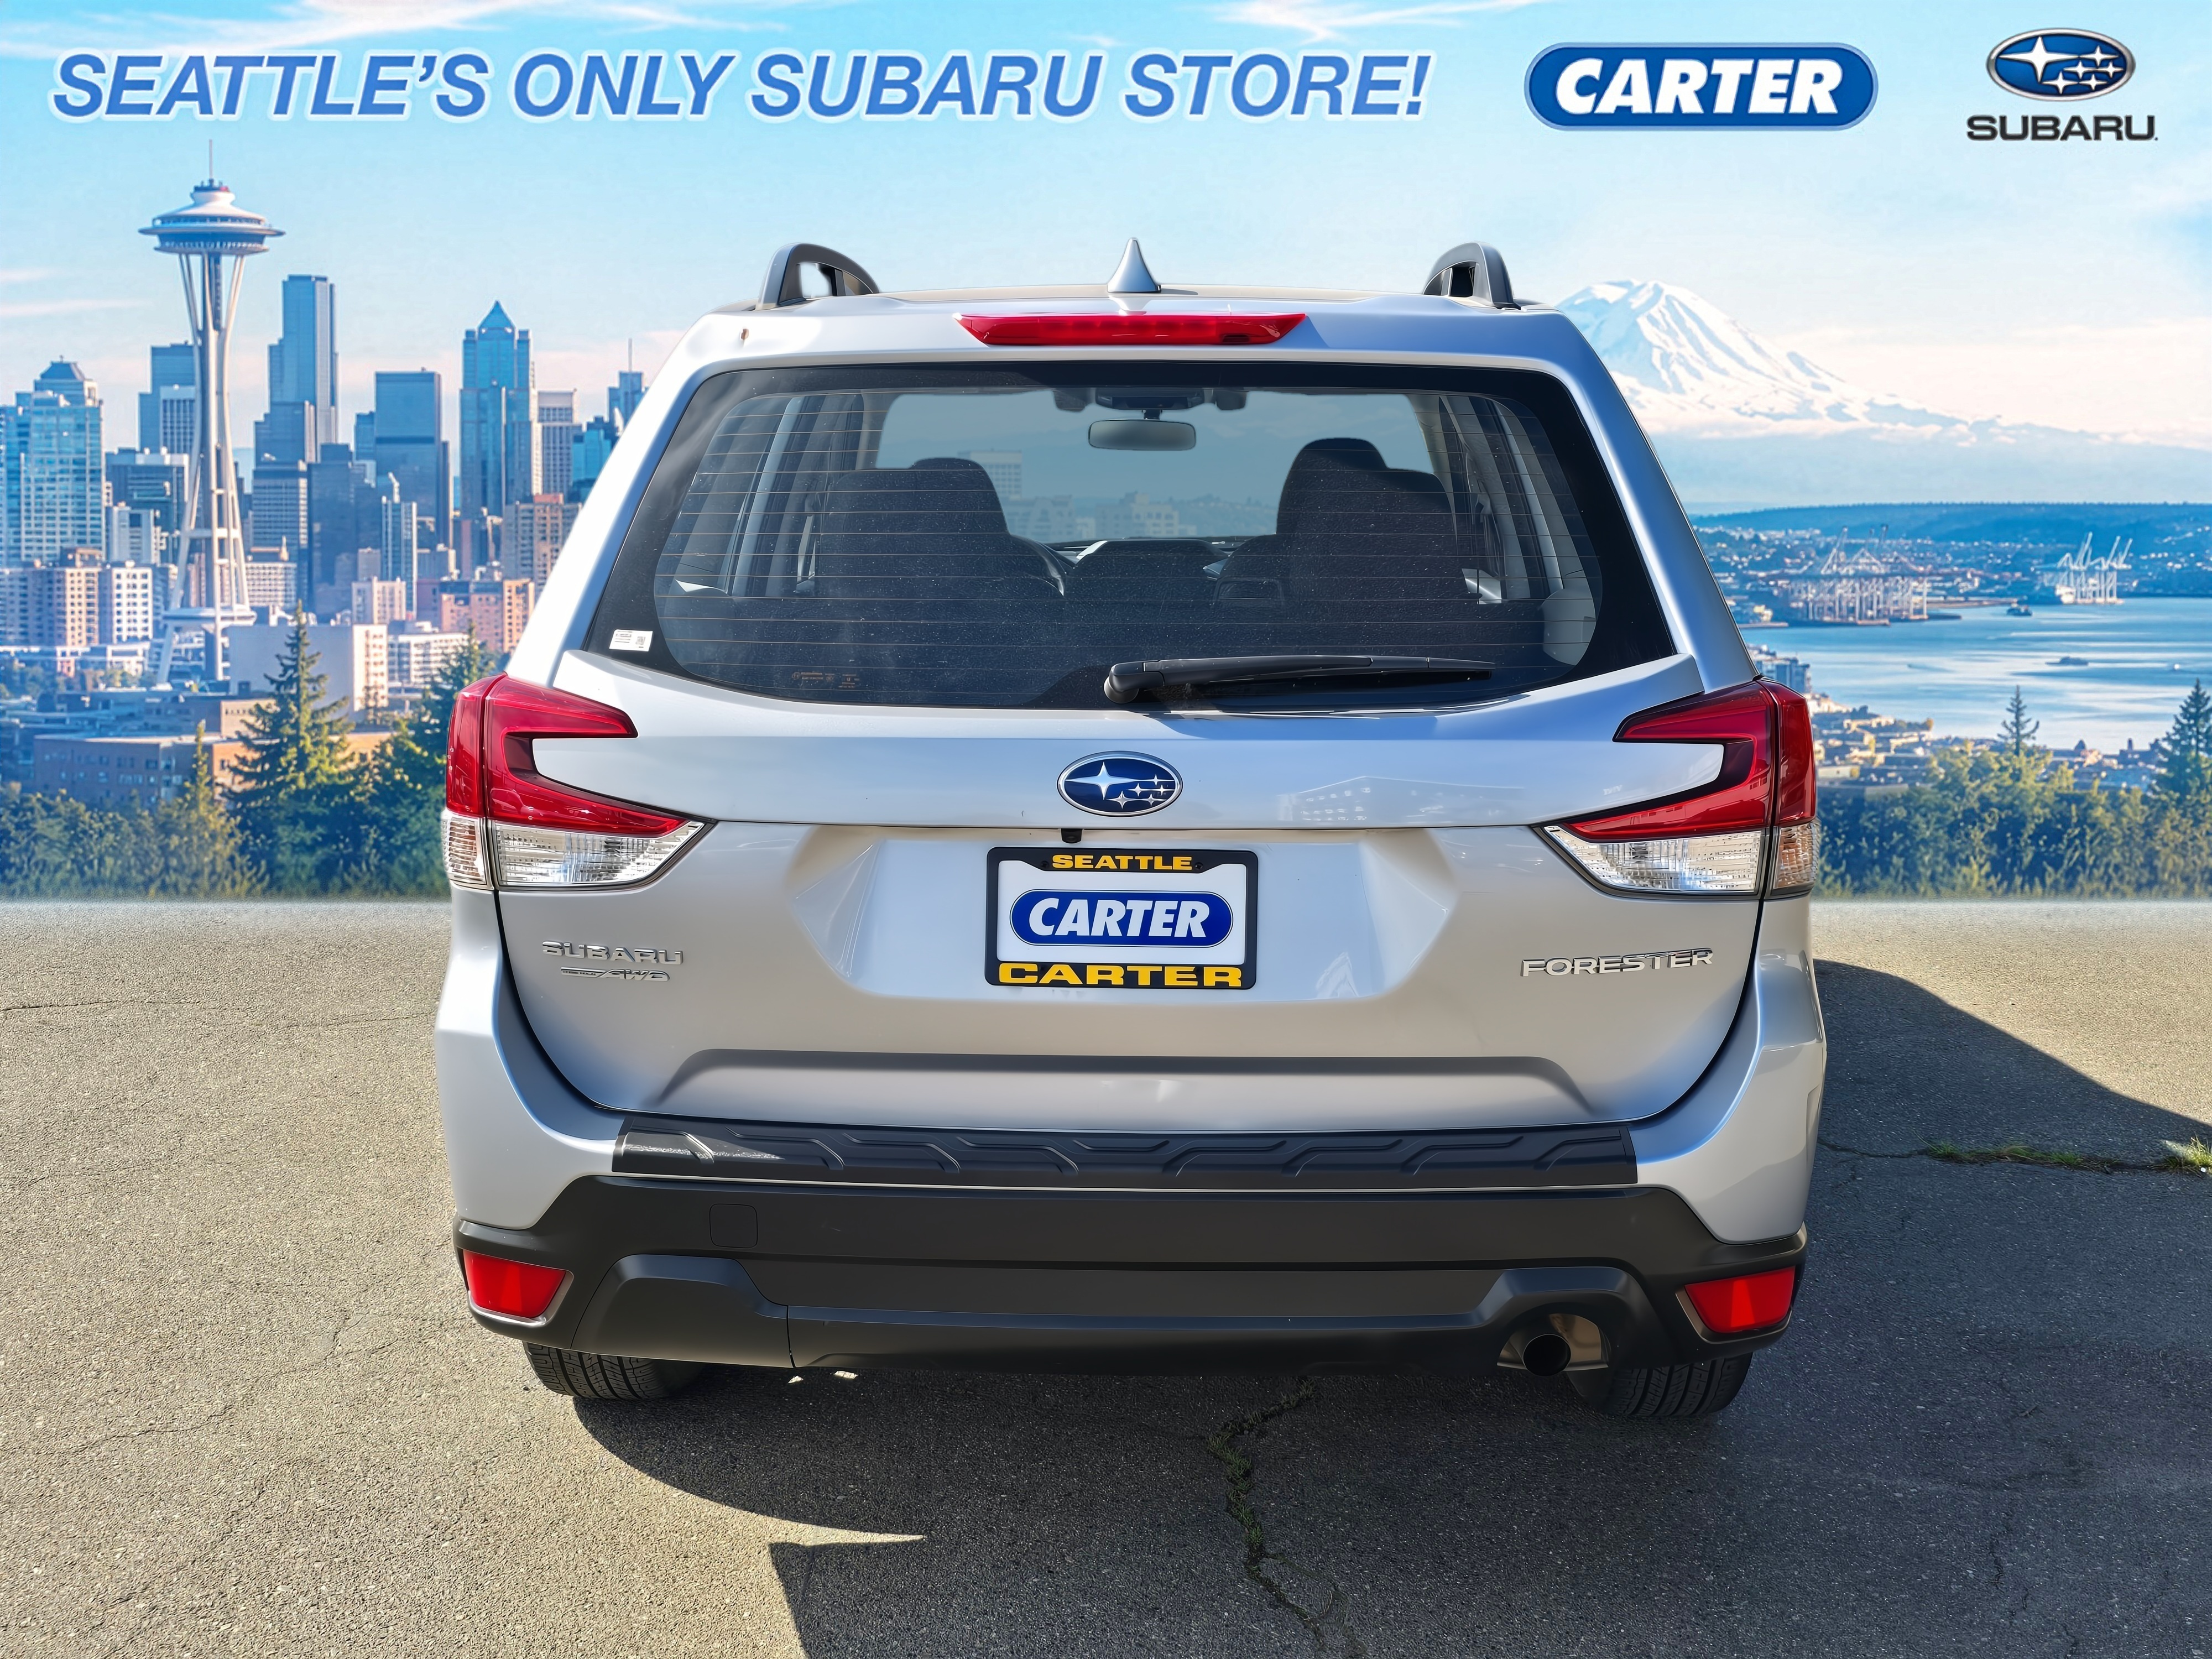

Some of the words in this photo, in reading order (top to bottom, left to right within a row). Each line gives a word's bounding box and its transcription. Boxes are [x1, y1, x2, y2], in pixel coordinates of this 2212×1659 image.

[1052, 854, 1193, 871] SEATTLE
[1029, 898, 1211, 938] CARTER
[541, 940, 684, 966] SUBARU
[1520, 947, 1714, 977] FORESTER
[598, 969, 670, 982] AWD
[999, 962, 1243, 988] CARTER
